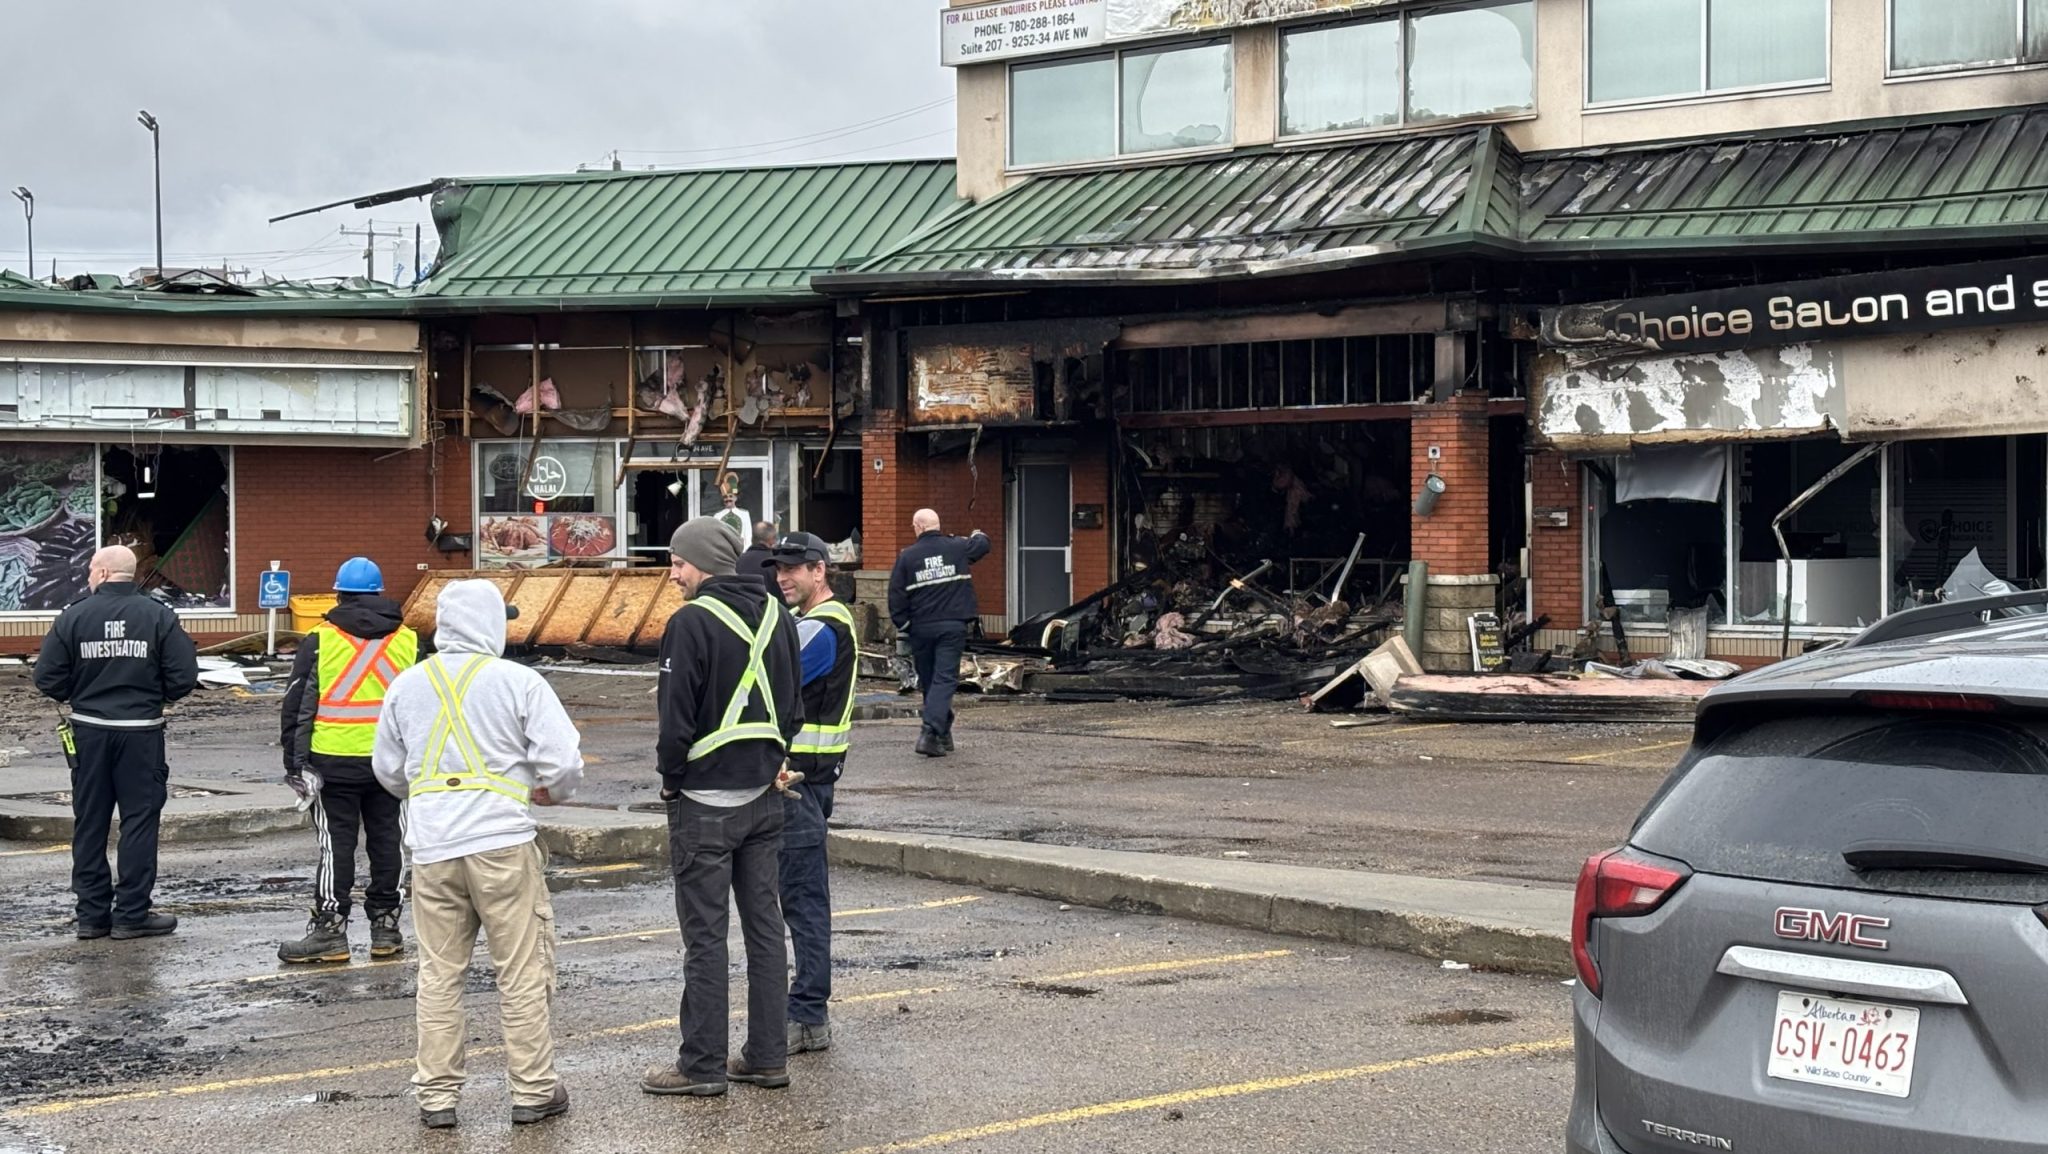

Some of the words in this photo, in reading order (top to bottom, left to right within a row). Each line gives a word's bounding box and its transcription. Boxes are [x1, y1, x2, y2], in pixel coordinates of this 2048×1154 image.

[946, 14, 960, 25] FOR
[962, 11, 974, 23] ALL
[976, 8, 998, 21] LEASE
[1000, 2, 1037, 16] INQUIRIES
[974, 23, 1006, 38] PHONE:
[1009, 12, 1075, 32] 780-288-1864
[961, 43, 982, 55] Suite
[985, 39, 1001, 52] 207
[1012, 32, 1050, 48] 9252-34
[1053, 29, 1070, 42] AVE
[1073, 26, 1089, 39] NW
[1926, 274, 2015, 317] and
[534, 484, 557, 493] HALAL
[1944, 520, 1993, 533] HOICE
[924, 555, 944, 569] FIRE
[104, 620, 126, 639] FIRE
[80, 639, 148, 659] INVESTIGATOR
[1774, 906, 1890, 949] GMC
[1804, 1000, 1849, 1021] Alberta
[1805, 1065, 1821, 1076] Wild
[1843, 1071, 1871, 1084] County
[1641, 1119, 1733, 1151] TERRAIN
